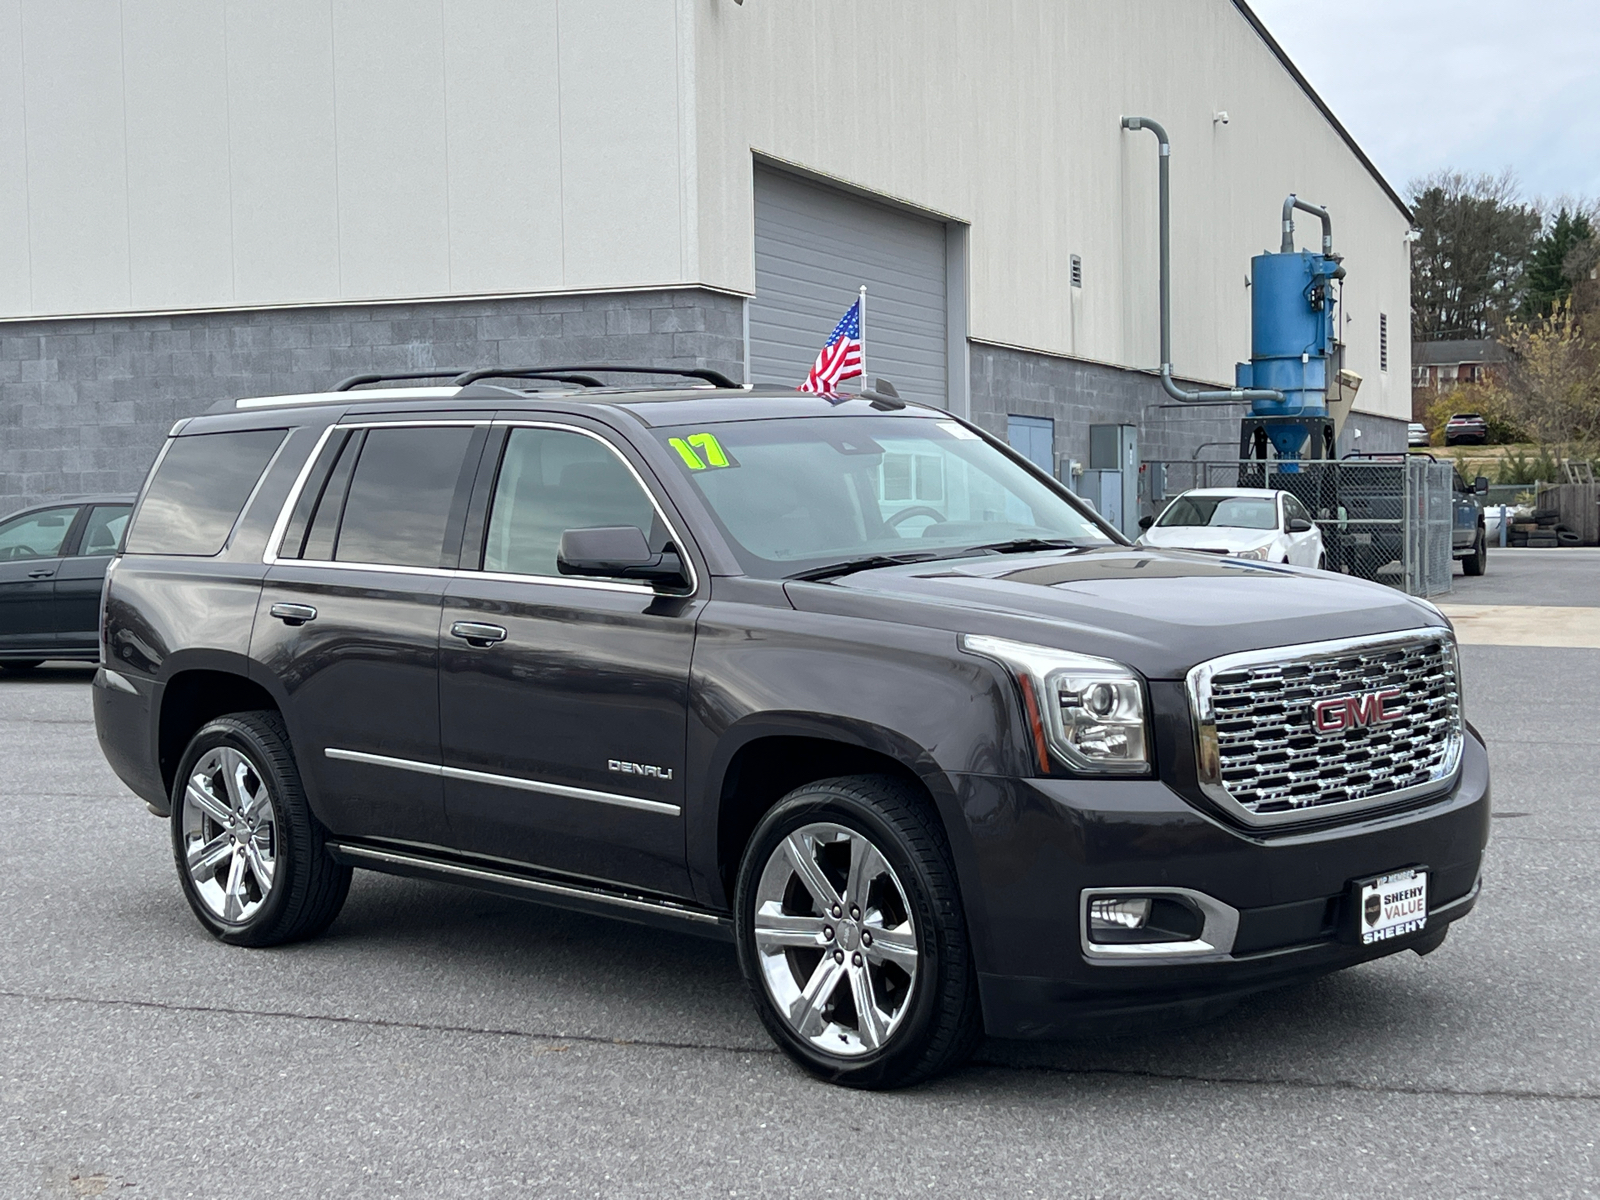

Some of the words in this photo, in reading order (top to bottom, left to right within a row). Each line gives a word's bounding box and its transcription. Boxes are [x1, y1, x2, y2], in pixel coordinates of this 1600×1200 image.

[668, 432, 730, 469] 17
[1314, 688, 1403, 733] GMC
[607, 759, 673, 780] DENALI
[1384, 886, 1424, 905] SHEEHY
[1384, 898, 1424, 920] VALUE
[1362, 917, 1427, 945] SHEEHY
